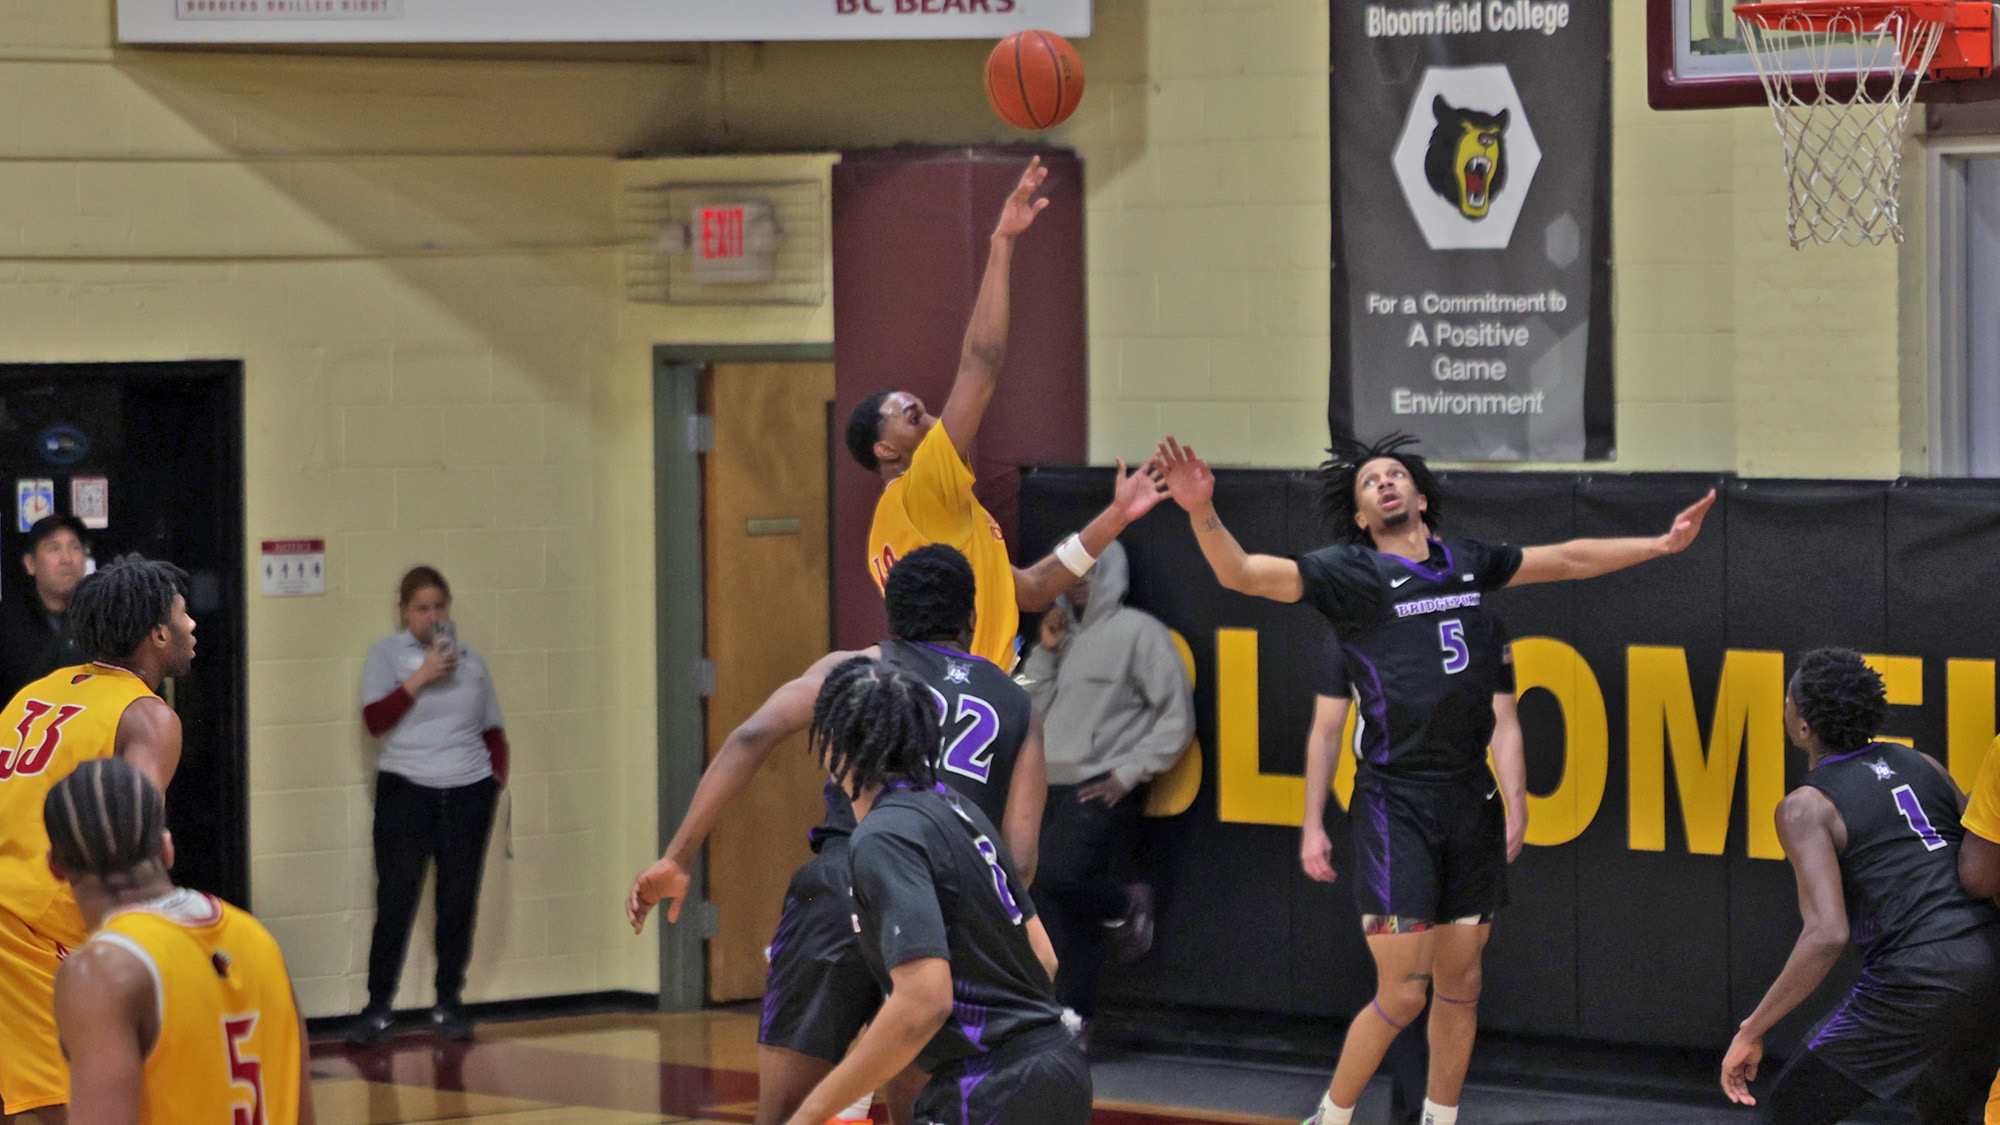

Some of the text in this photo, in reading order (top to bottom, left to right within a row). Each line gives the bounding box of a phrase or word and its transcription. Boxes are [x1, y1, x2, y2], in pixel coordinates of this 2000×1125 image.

[895, 0, 1017, 15] BEARS
[1368, 0, 1570, 37] Bloomfield College
[703, 207, 744, 259] EXIT
[1368, 290, 1567, 314] For a Commitment to
[1406, 322, 1530, 348] A Positive
[1434, 355, 1507, 381] Game
[1392, 387, 1545, 414] Environment
[1438, 618, 1470, 675] 5
[0, 698, 87, 781] 33
[924, 684, 1000, 785] 2
[1891, 783, 1948, 852] 1
[221, 1010, 269, 1125] 5
